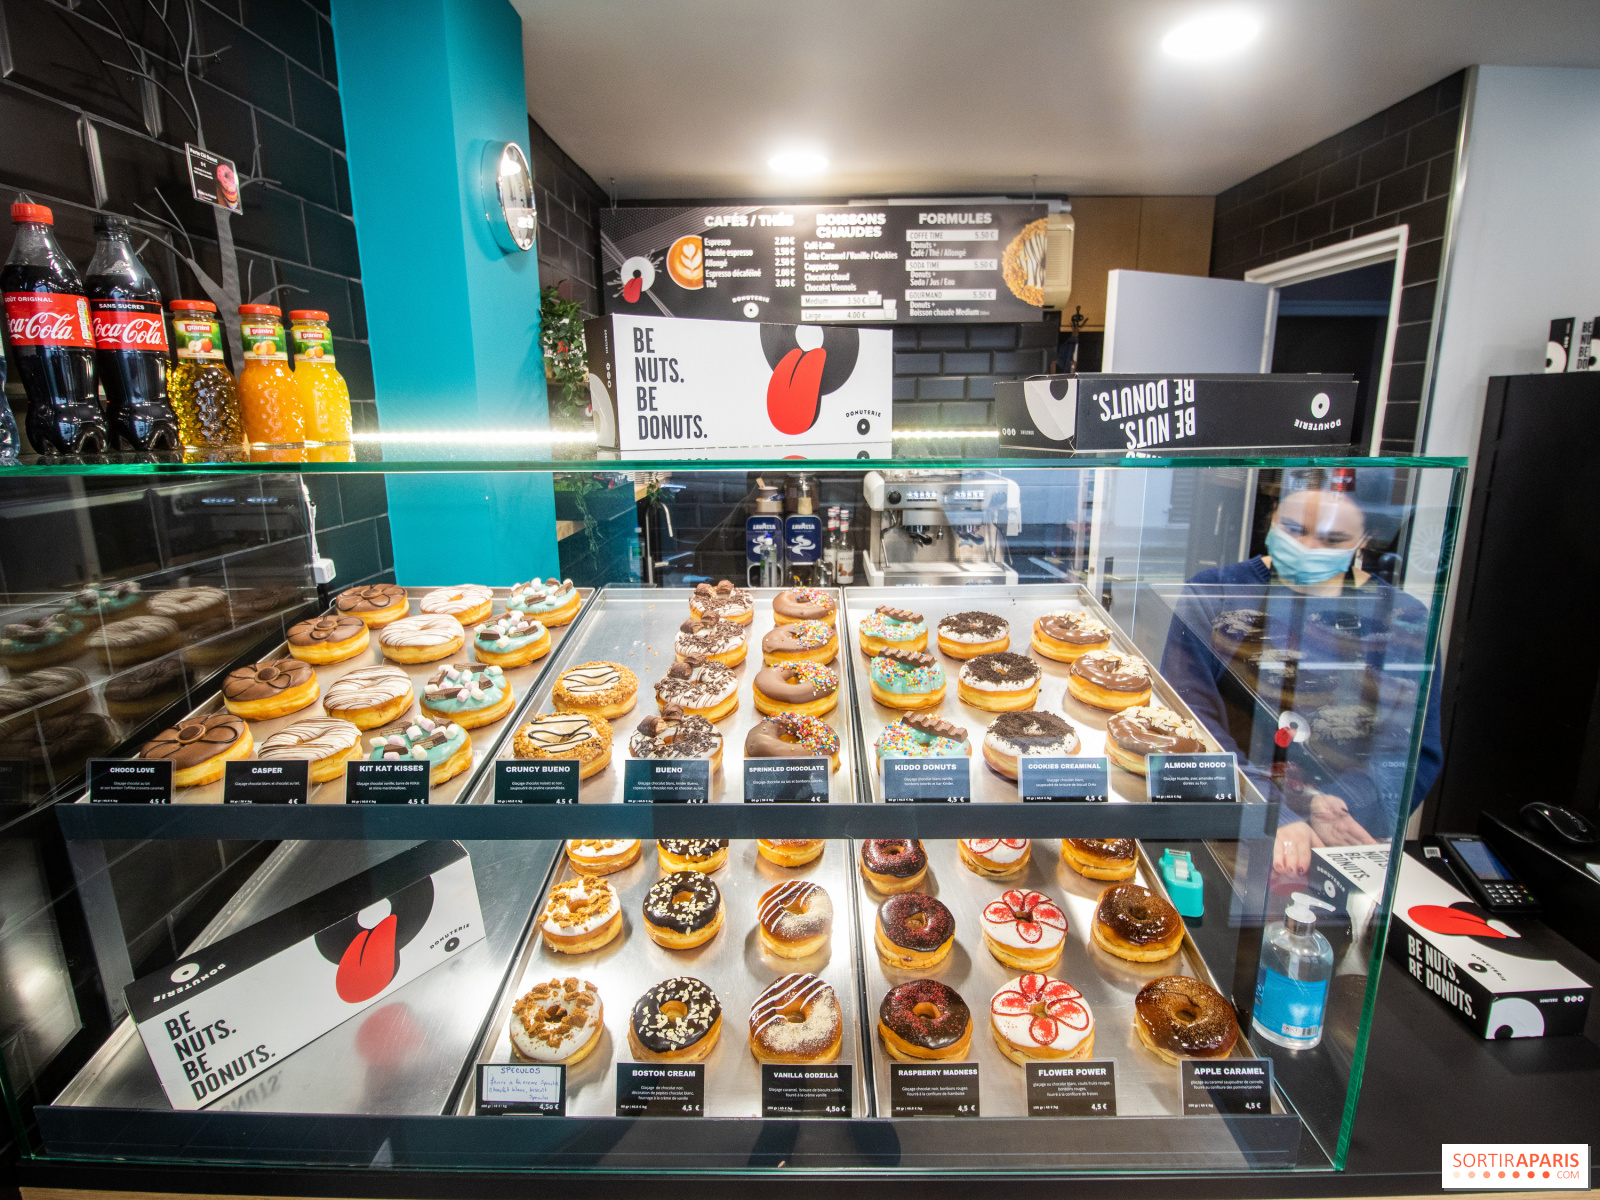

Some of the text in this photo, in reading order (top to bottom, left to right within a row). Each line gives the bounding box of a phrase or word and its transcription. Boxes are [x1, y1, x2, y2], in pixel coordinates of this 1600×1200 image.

[704, 211, 795, 227] CAFÉS THÉS
[815, 213, 886, 226] BOISSONS
[918, 212, 993, 224] FORMULES
[815, 226, 883, 238] CHAUDES
[974, 231, 989, 239] 5.50
[704, 238, 731, 247] Espresso
[804, 241, 818, 250] Café
[704, 248, 754, 258] Double espresso
[820, 251, 846, 260] Caramel
[874, 251, 898, 260] Cookies
[910, 248, 966, 258] Café Thé Allongé
[704, 259, 728, 269] Allongé
[774, 257, 789, 266] 2.50
[926, 261, 940, 269] TIME
[804, 262, 839, 272] Cappuccino
[705, 269, 732, 279] Espresso
[774, 268, 789, 277] 2.00
[804, 272, 850, 281] Chocolat chaud
[705, 280, 717, 288] Thé
[775, 279, 789, 287] 3.00
[804, 283, 831, 291] Chocolat
[910, 278, 955, 286] Soda Jus Eau
[732, 295, 770, 303] DONUTERIE
[909, 291, 942, 299] GOURMAND
[910, 301, 931, 309] Donuts
[805, 312, 821, 321] Large
[910, 309, 933, 317] Boisson
[933, 308, 955, 316] chaude
[955, 308, 979, 316] Medium
[187, 324, 210, 333] granini
[251, 328, 274, 336] granini
[633, 327, 655, 353] BE
[635, 357, 684, 383] NUTS.
[636, 386, 658, 412] BE
[1092, 379, 1168, 421] DONUTS.
[845, 409, 882, 418] DONUTERIE
[638, 414, 708, 440] DONUTS.
[1119, 407, 1196, 450] BE NUTS.
[1294, 418, 1342, 431] DONUTERIE
[1344, 852, 1366, 860] BE
[1316, 866, 1346, 892] DONUTERIE
[430, 923, 471, 950] DONUTERIE
[1408, 933, 1460, 985] BE NUTS.
[1470, 953, 1507, 981] DONUTERIE
[153, 962, 227, 1003] DONUTERIE
[1425, 967, 1476, 1020] DONUTS.
[164, 1011, 197, 1041] BE
[173, 1019, 237, 1062] NUTS.
[183, 1053, 213, 1082] BE
[190, 1044, 276, 1101] DONUTS.
[1038, 1068, 1107, 1077] FLOWER POWER
[1194, 1067, 1265, 1075] APPLE CARAMEL
[682, 1104, 692, 1112] 4,5
